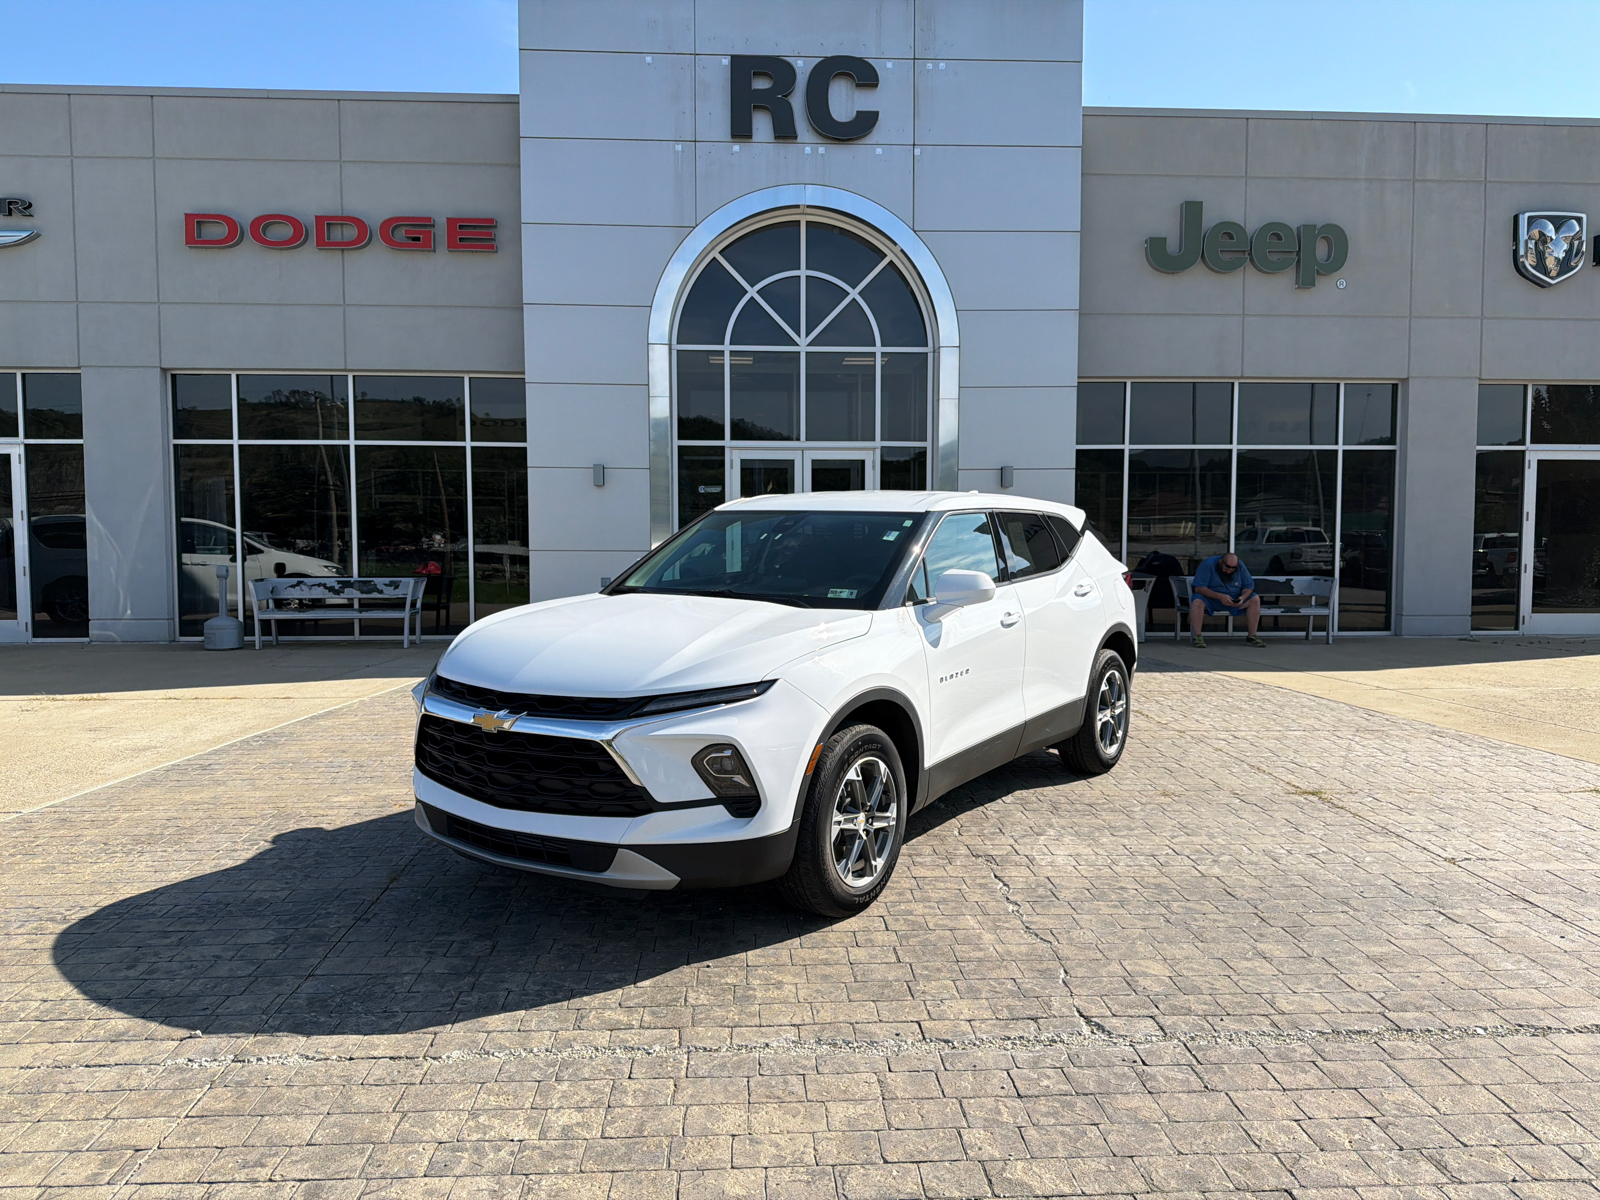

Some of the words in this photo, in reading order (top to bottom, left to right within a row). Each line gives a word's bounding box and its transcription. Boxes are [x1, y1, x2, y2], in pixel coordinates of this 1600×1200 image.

[730, 55, 880, 141] RC
[184, 213, 497, 252] DODGE
[1145, 200, 1349, 289] Jeep
